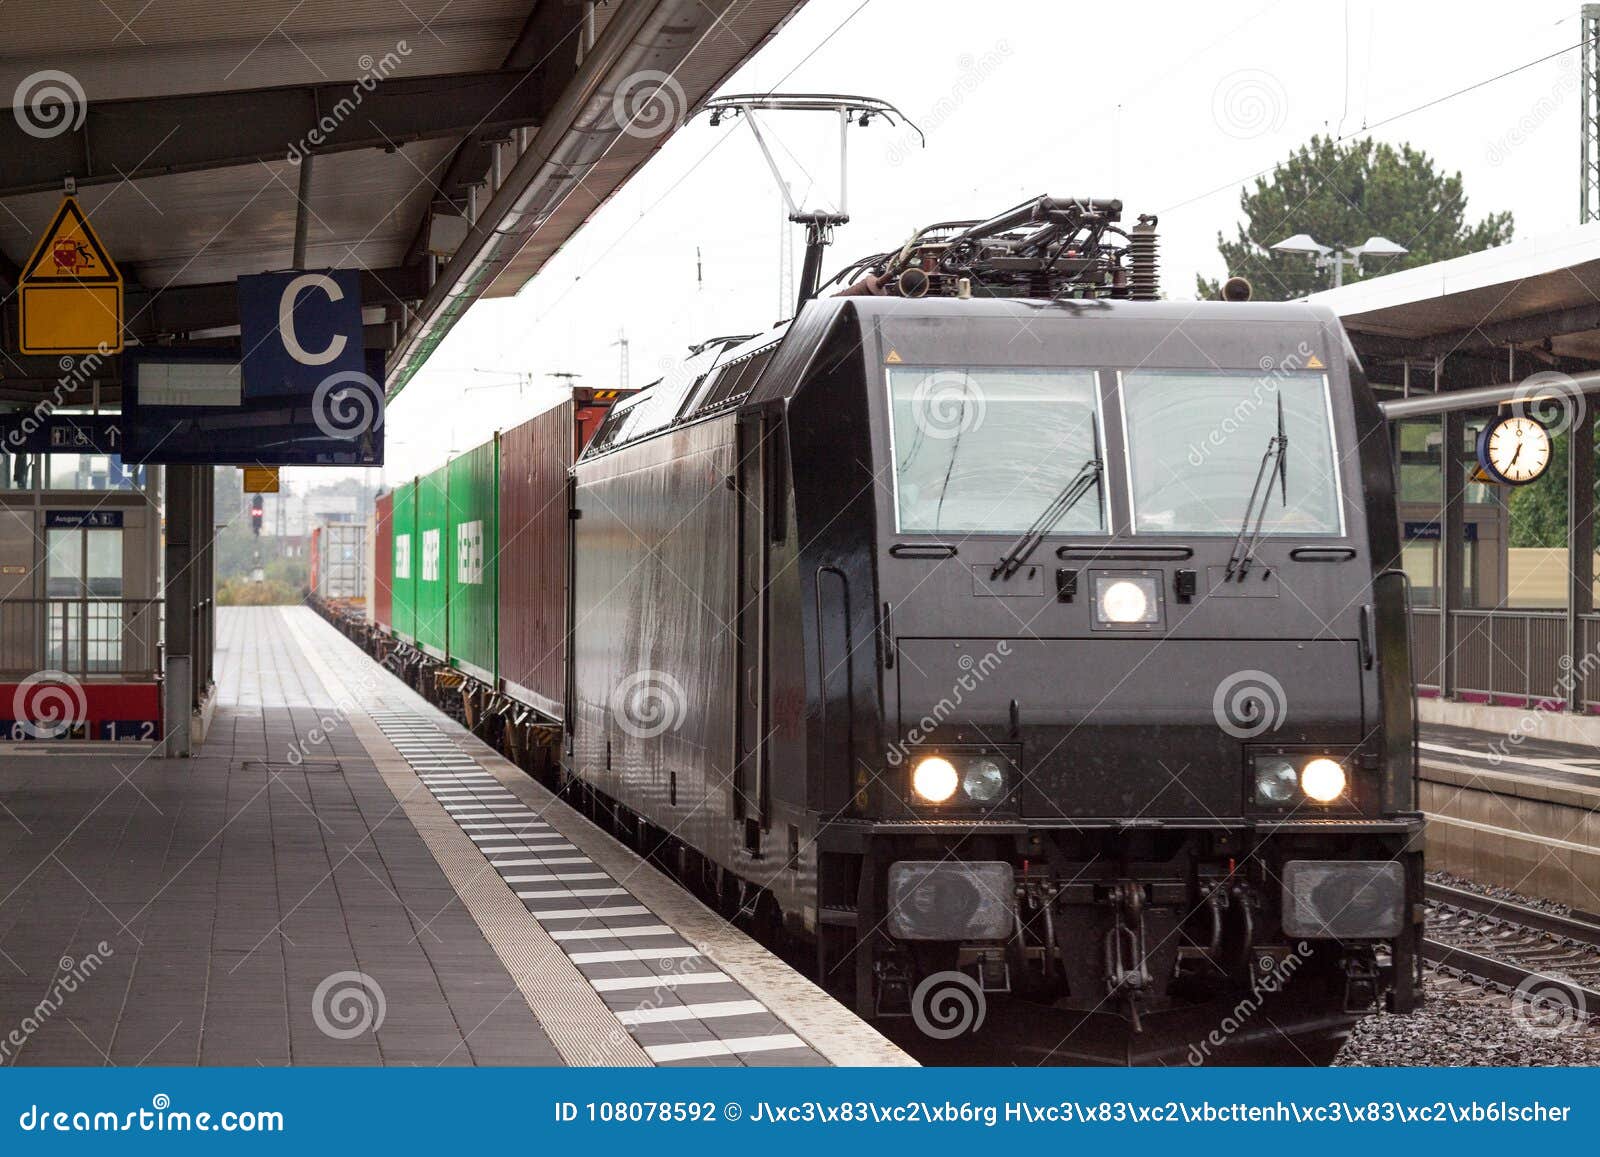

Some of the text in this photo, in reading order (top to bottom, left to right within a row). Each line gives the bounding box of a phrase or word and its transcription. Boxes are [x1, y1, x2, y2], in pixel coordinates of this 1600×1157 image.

[279, 273, 348, 366] C
[107, 722, 116, 741] 1
[141, 722, 154, 741] 2
